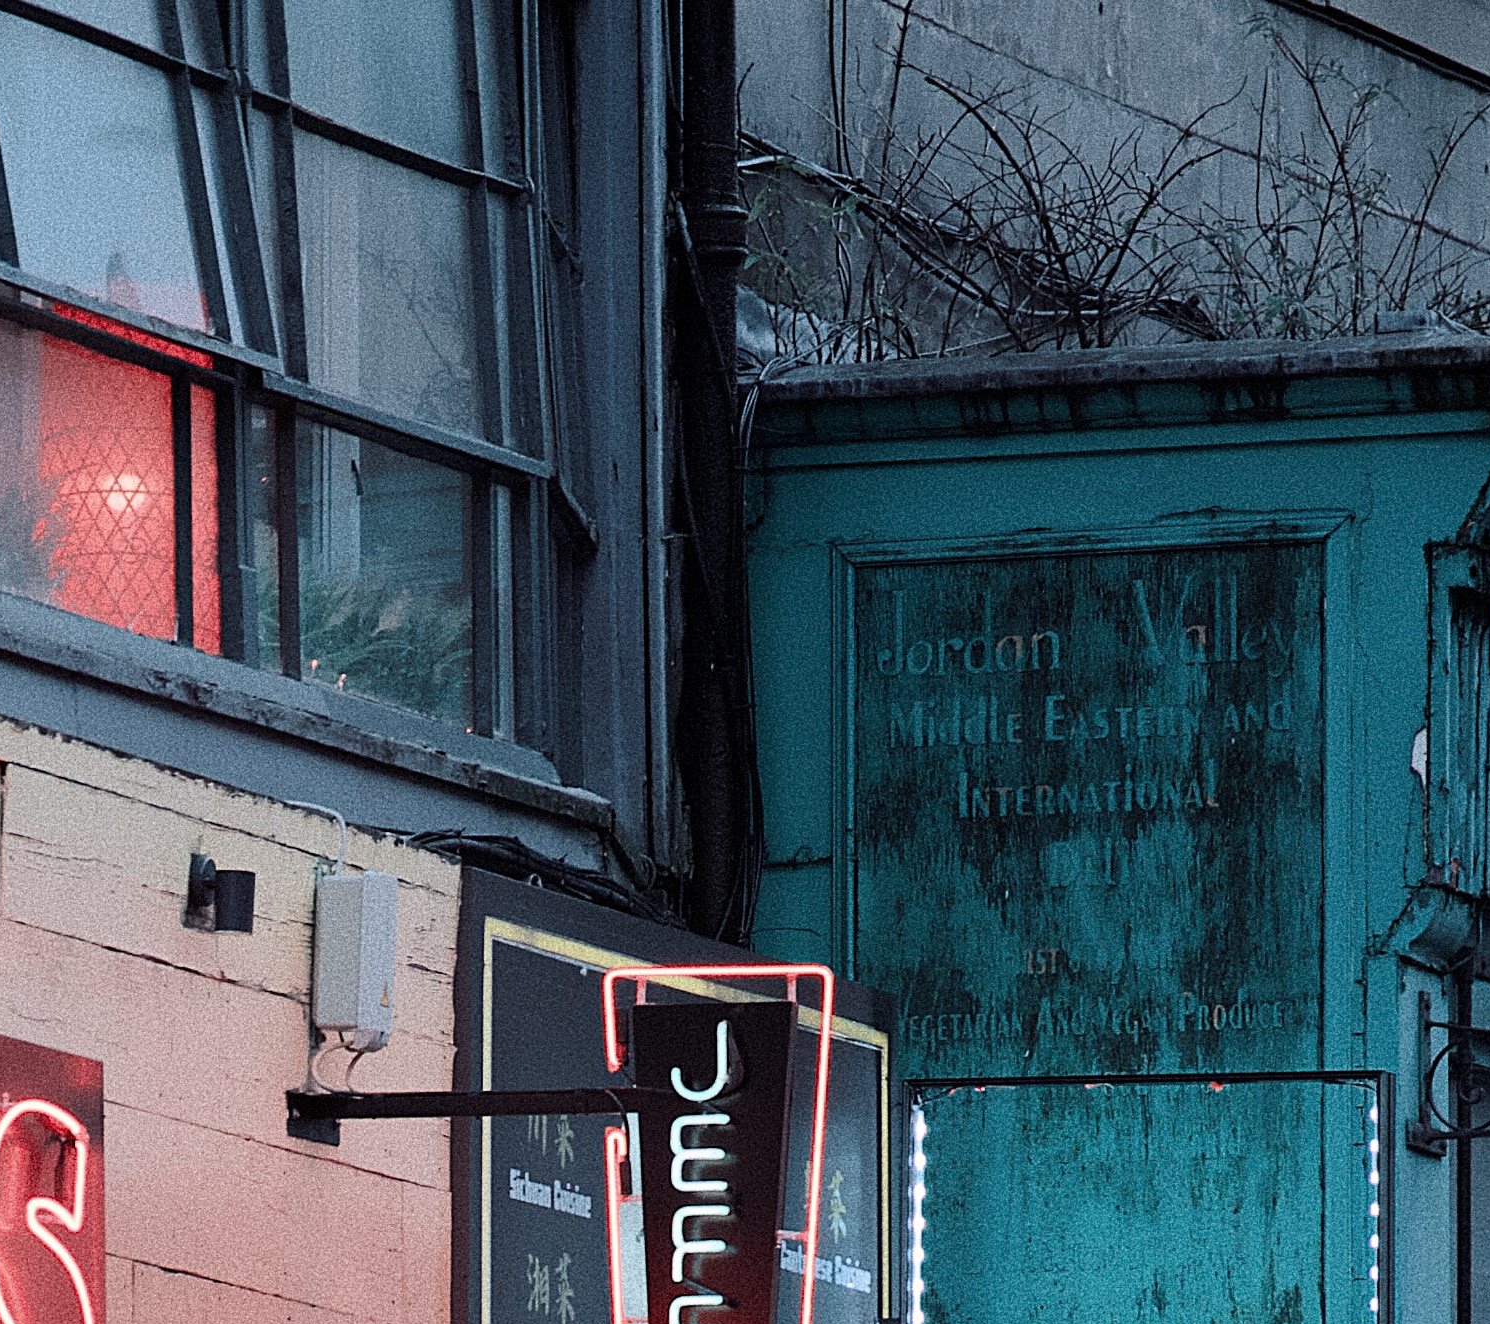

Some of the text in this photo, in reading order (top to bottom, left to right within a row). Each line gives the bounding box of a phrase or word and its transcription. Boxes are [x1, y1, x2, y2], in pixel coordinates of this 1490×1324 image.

[878, 590, 1061, 676] Jordan
[509, 1167, 592, 1219] Sichuan Cuisine
[834, 1256, 872, 1294] Cuisine
